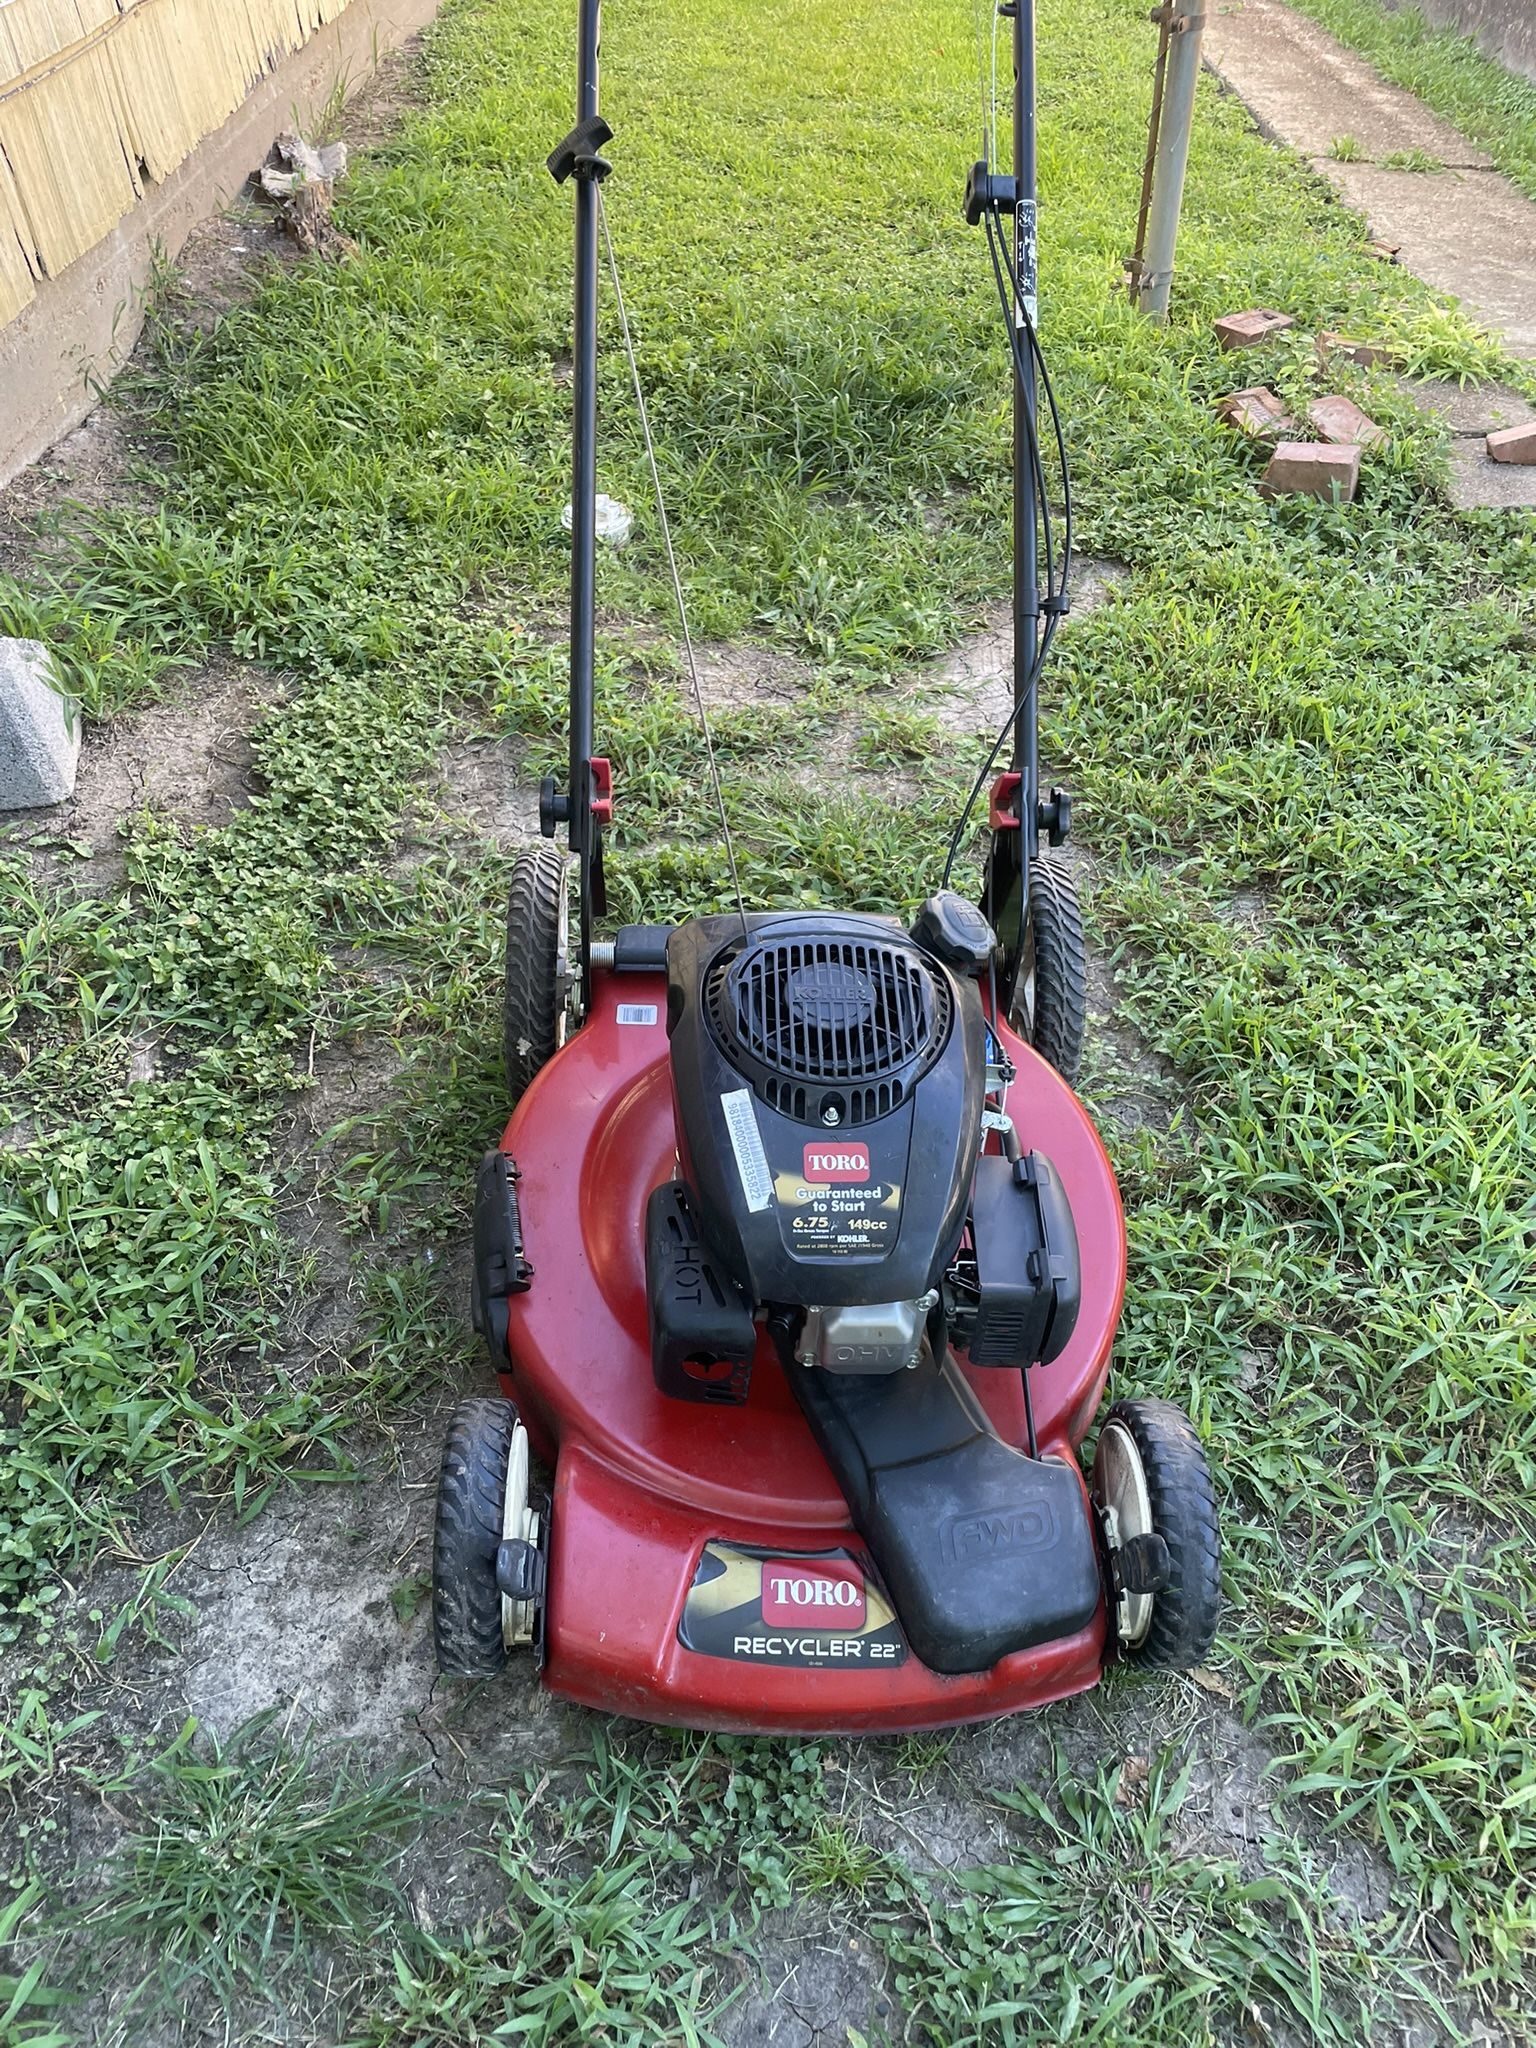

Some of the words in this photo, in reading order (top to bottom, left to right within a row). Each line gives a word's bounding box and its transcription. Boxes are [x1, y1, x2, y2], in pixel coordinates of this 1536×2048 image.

[796, 1186, 882, 1199] Guaranteed
[813, 1201, 828, 1212] to
[831, 1200, 866, 1212] Start
[792, 1216, 829, 1228] 6.75
[847, 1218, 888, 1230] 149cc
[674, 1246, 702, 1305] HOT
[952, 1510, 1045, 1561] FWD
[733, 1636, 863, 1658] RECYCLER
